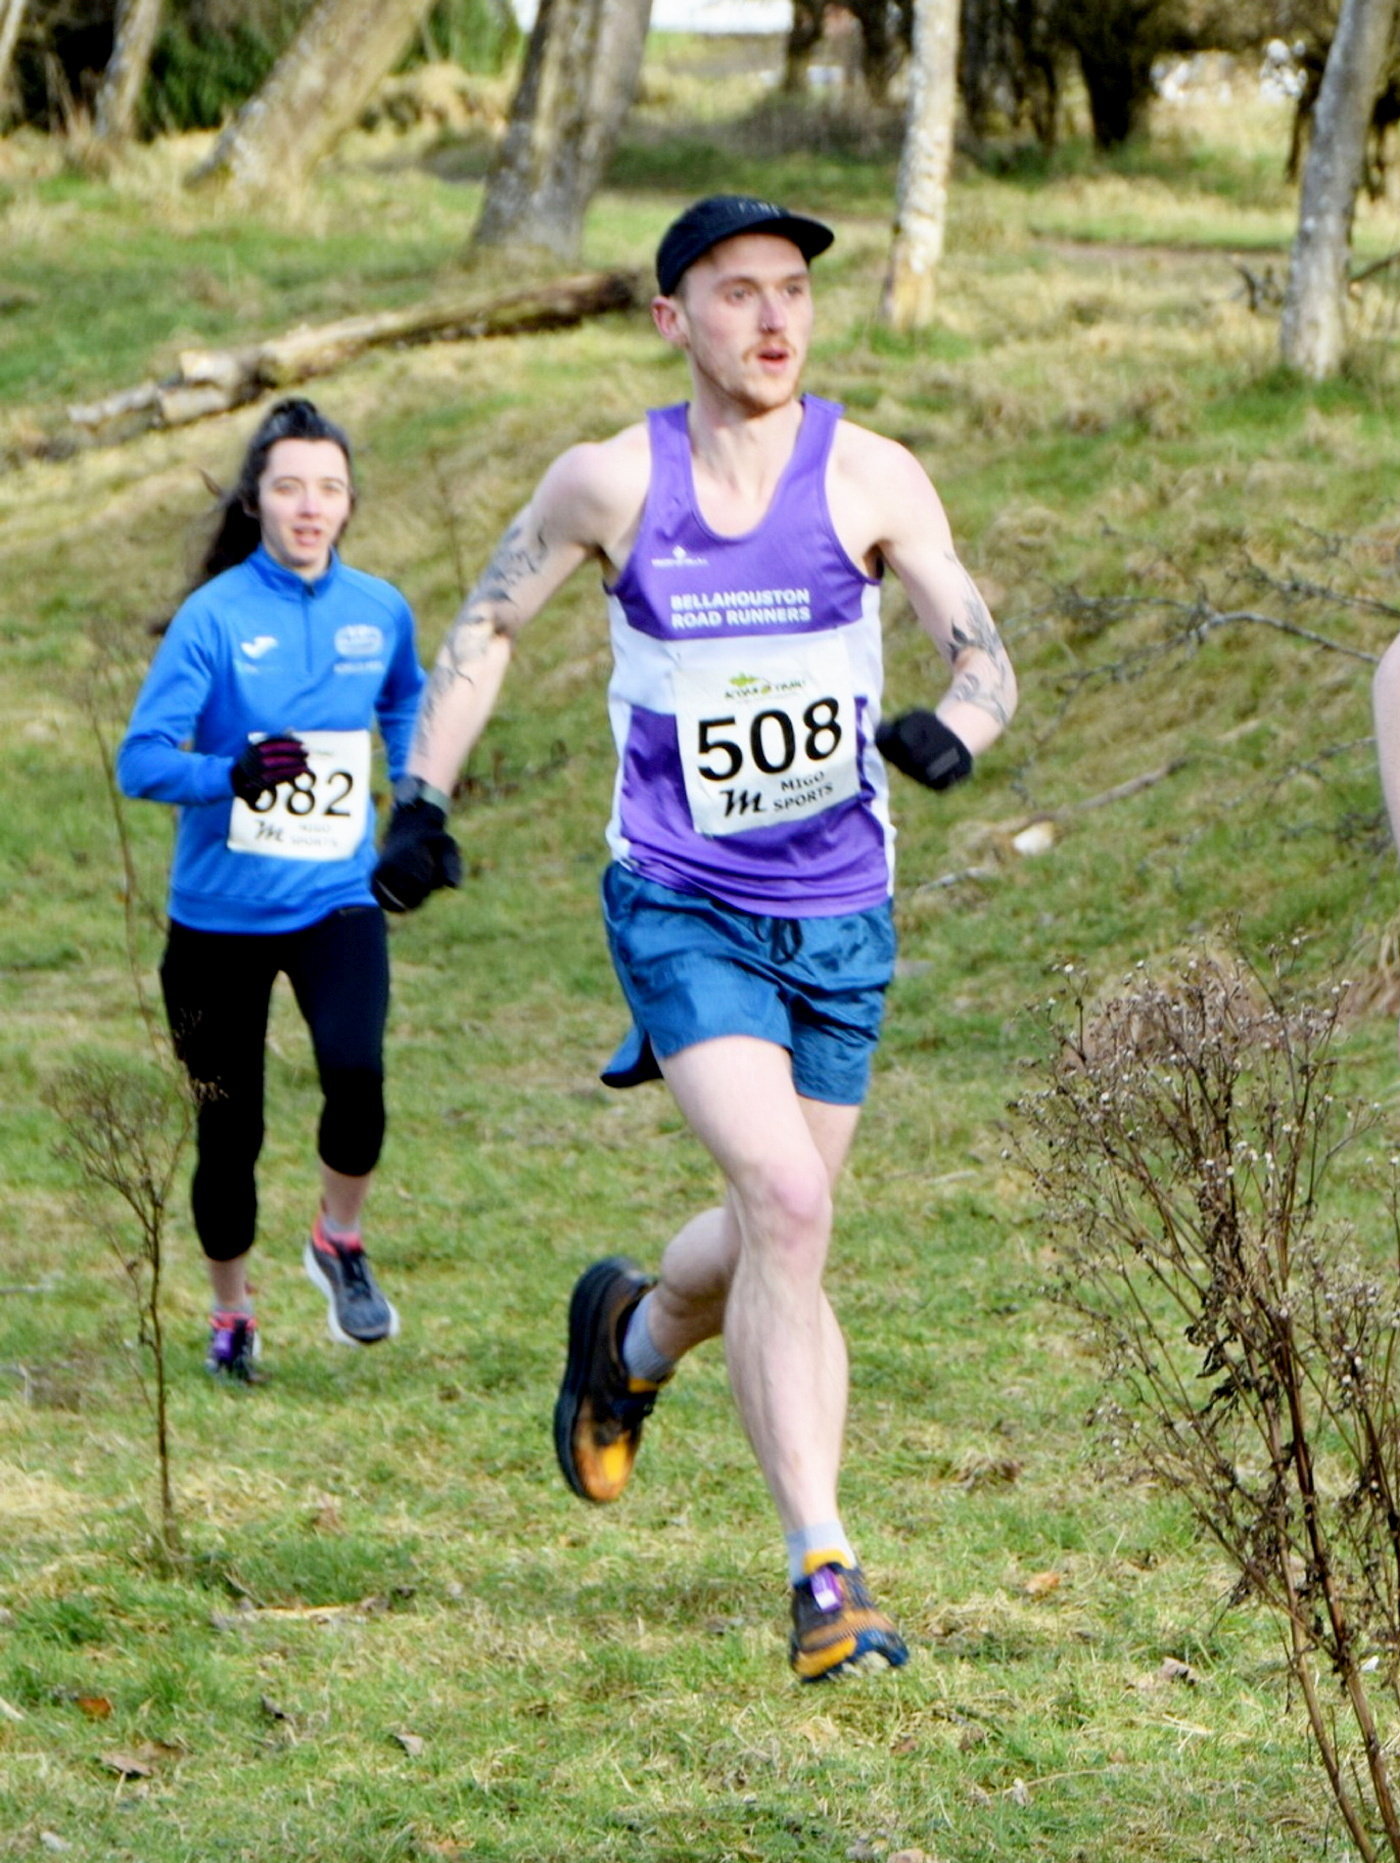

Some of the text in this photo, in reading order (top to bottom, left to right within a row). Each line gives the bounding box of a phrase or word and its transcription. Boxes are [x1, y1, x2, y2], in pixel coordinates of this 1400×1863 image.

[671, 588, 810, 612] BELLAHOUSTON
[672, 606, 811, 630] ROAD RUNNERS
[698, 697, 842, 782] 508
[773, 782, 833, 811] SPORTS
